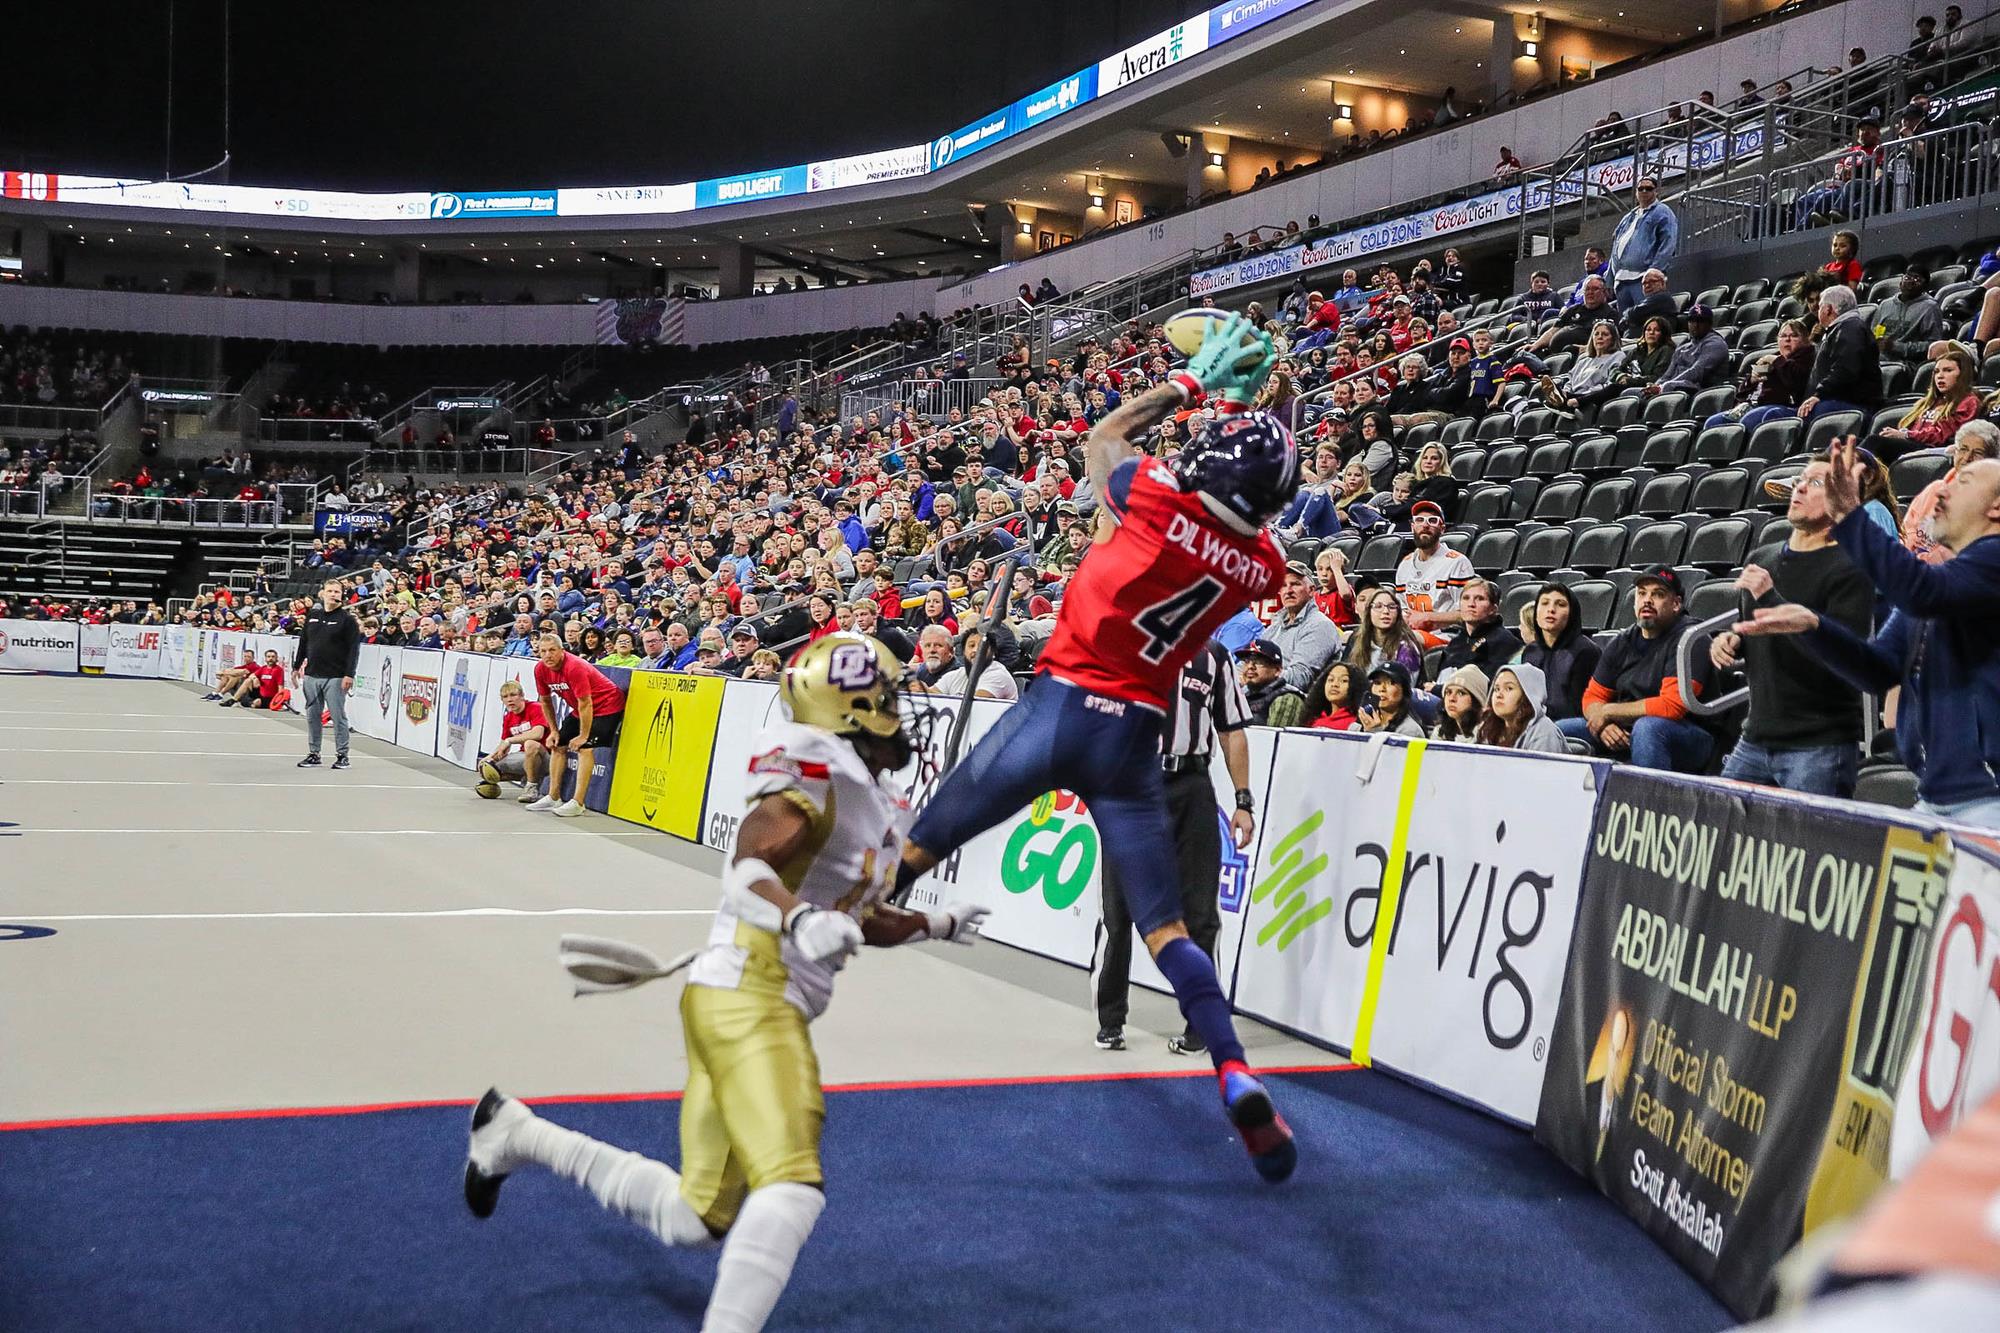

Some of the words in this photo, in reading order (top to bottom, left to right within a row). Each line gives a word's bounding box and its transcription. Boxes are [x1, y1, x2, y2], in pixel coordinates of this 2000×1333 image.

[1117, 46, 1167, 86] Avera
[1690, 136, 1733, 167] COL
[17, 173, 48, 199] 10
[596, 187, 664, 201] SANFORD
[718, 182, 744, 200] BUD
[744, 175, 783, 196] LIGHT
[866, 169, 899, 180] PREMIER
[1599, 163, 1634, 188] Coor
[287, 198, 310, 213] SD
[1433, 208, 1468, 232] Coors
[1468, 202, 1499, 225] LIGHT
[1149, 224, 1164, 242] 115
[1329, 240, 1355, 261] LIGHT
[1360, 227, 1391, 252] COLD
[1391, 218, 1423, 245] ZONE
[1190, 273, 1214, 295] Coors
[1213, 271, 1236, 289] LIGHT
[1239, 260, 1265, 284] COLD
[1265, 255, 1292, 277] ZONE
[1166, 513, 1273, 595] DILWORTH
[1132, 574, 1227, 666] 4
[11, 637, 74, 649] nutrition
[1083, 693, 1126, 718] STORM
[1000, 815, 1098, 911] GO
[1597, 800, 1718, 891] JOHNSON
[1717, 830, 1874, 942] JANKLOW
[1344, 819, 1555, 1050] arvig
[1611, 903, 1753, 1020] ABDALLAH
[1747, 967, 1798, 1041] LLP
[1641, 1017, 1706, 1094] Official
[1711, 1053, 1766, 1136] Storm
[1628, 1075, 1676, 1142] Team
[1676, 1098, 1754, 1216] Attorney
[1630, 1147, 1664, 1208] Scott
[1663, 1176, 1725, 1259] Abdallah
